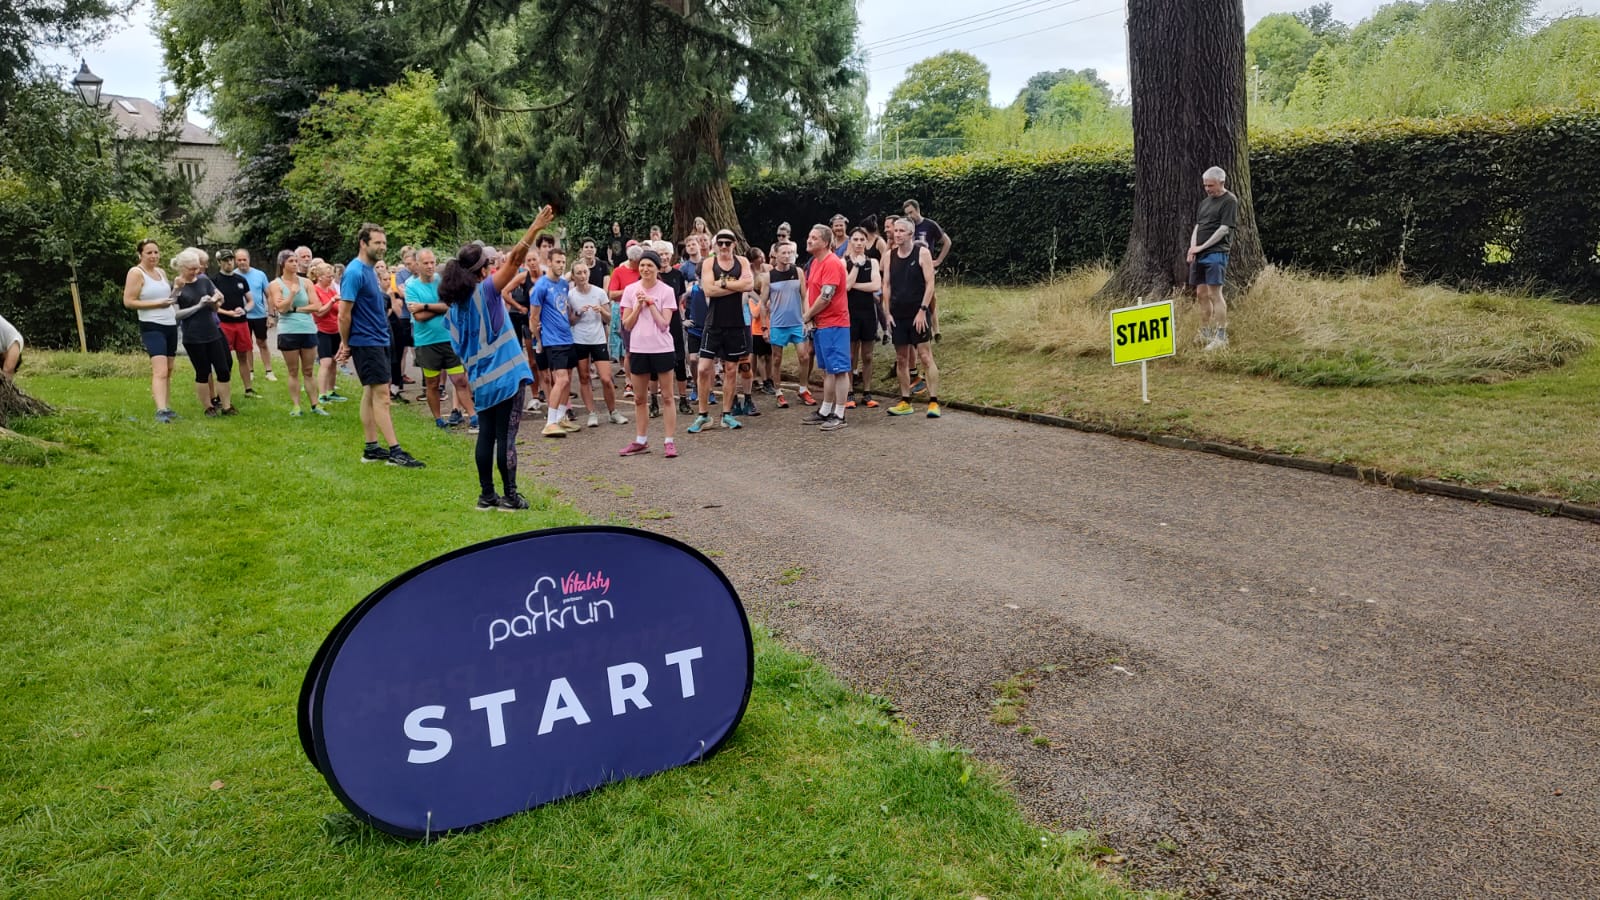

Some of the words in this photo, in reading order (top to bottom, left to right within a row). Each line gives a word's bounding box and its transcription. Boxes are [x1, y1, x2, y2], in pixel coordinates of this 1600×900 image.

[1116, 316, 1169, 346] START
[560, 569, 610, 596] Vitality
[489, 577, 614, 650] parkrun
[403, 646, 703, 764] START
